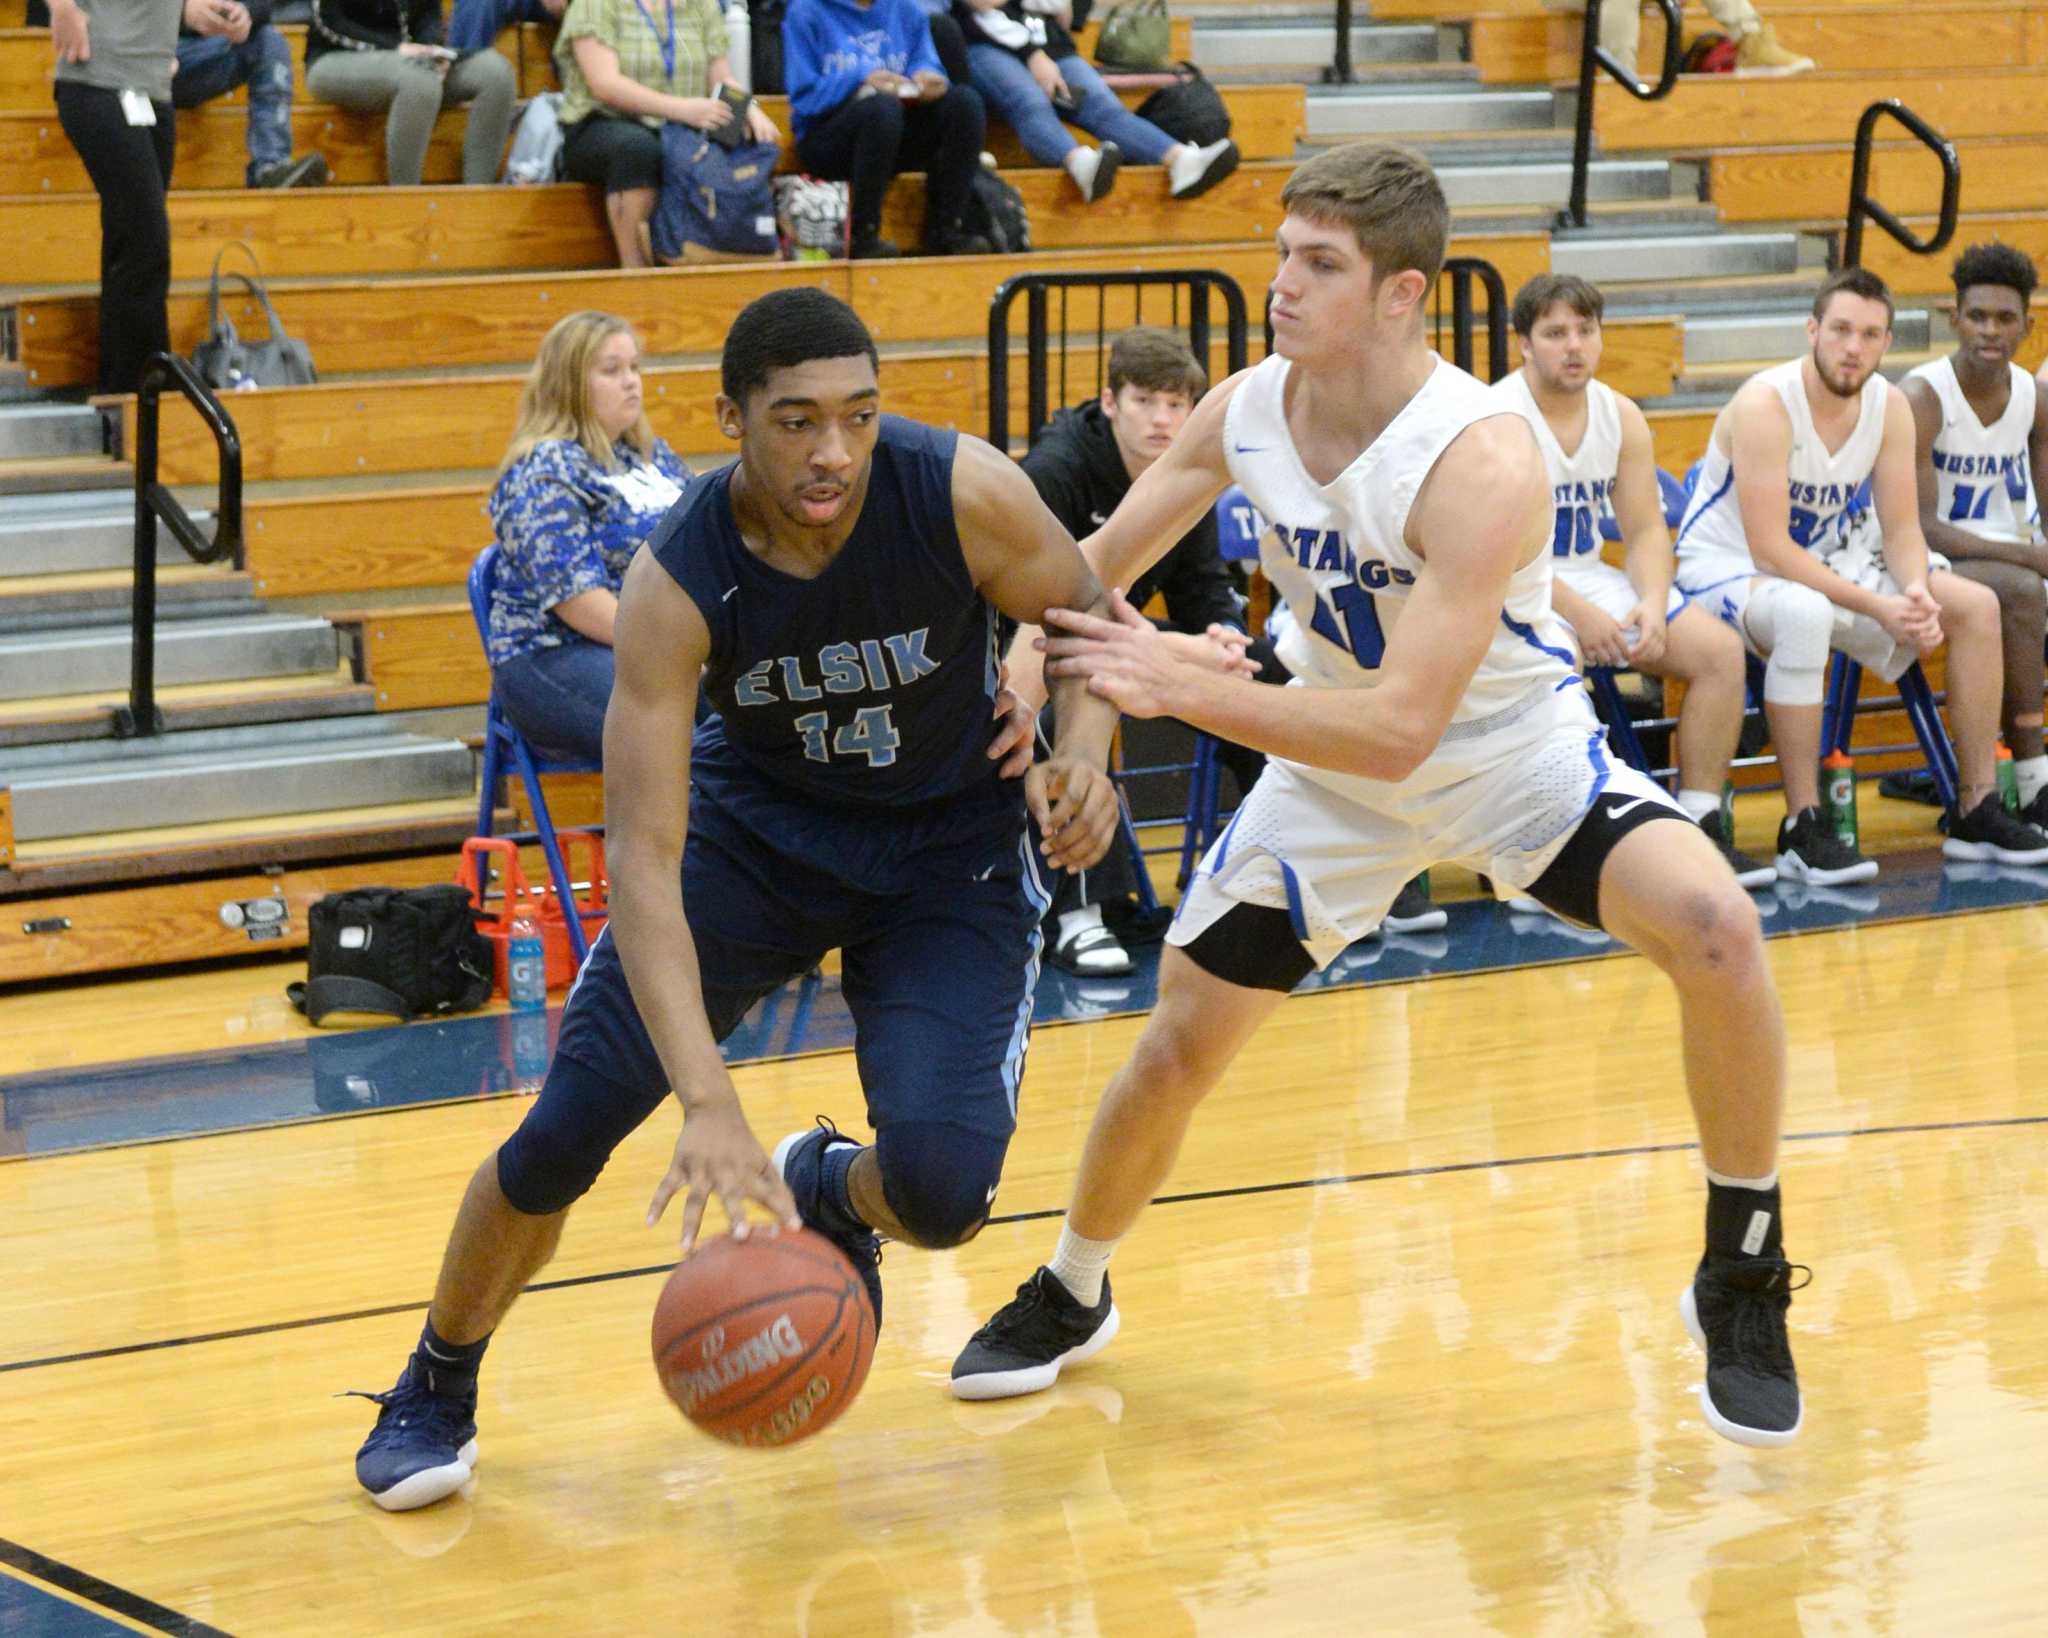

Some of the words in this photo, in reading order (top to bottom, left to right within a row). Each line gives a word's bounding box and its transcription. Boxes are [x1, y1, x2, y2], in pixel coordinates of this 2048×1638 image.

[1552, 505, 1595, 555] 10
[734, 627, 942, 707] ELSIK
[794, 703, 901, 767] 14
